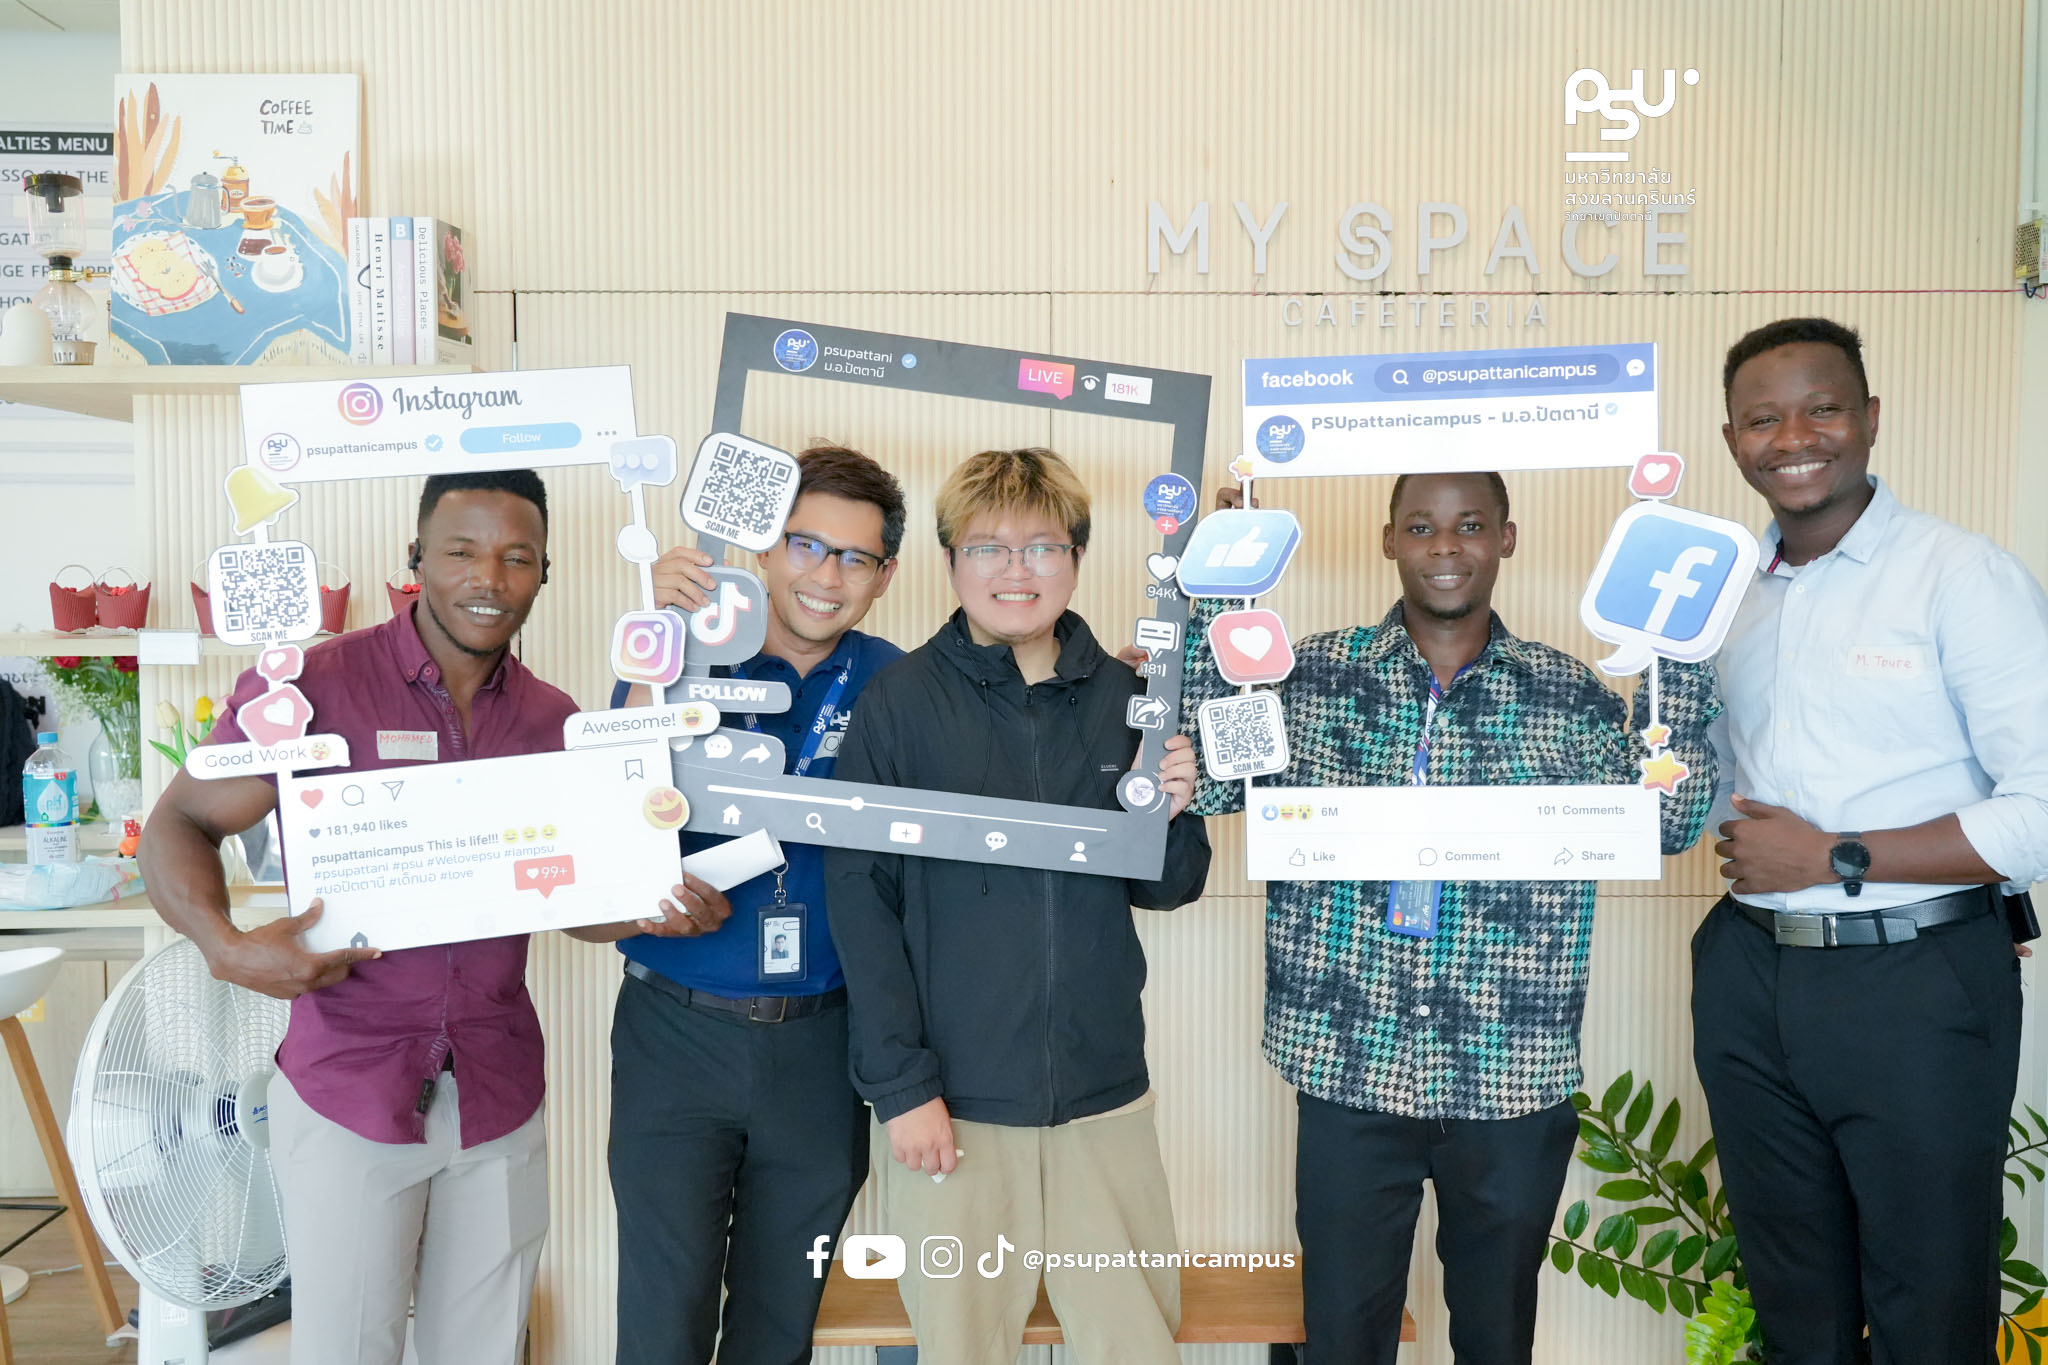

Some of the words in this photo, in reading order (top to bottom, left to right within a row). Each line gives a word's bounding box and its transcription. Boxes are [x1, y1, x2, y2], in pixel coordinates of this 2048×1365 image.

[259, 99, 313, 115] COFFEE
[260, 119, 294, 135] TIME
[58, 136, 107, 151] MENU
[77, 170, 109, 183] THE
[395, 223, 406, 238] B
[1147, 201, 1290, 275] MY
[1335, 200, 1690, 281] SPACE
[374, 233, 385, 279] Henri
[418, 226, 429, 285] Delicious
[376, 288, 386, 350] Matisse
[419, 291, 430, 330] Places
[1281, 299, 1548, 327] CAFETERIA
[823, 346, 893, 364] psupattani
[823, 362, 885, 378] ม.อ.ปัตตานี
[1028, 368, 1064, 385] LIVE
[1261, 368, 1354, 388] facebook
[1422, 364, 1598, 385] @psupattanicampus
[1112, 383, 1139, 396] 181K
[392, 385, 523, 420] Instagram
[1311, 413, 1482, 432] PSUpattanicampus
[1501, 403, 1600, 424] ม.อ.ปัตตานี
[502, 432, 541, 444] Follow
[306, 440, 418, 459] psupattanicampus
[705, 519, 727, 536] SCAN
[726, 526, 740, 540] ME
[250, 631, 273, 642] SCAN
[274, 630, 288, 640] ME
[688, 683, 767, 702] FOLLOW
[582, 712, 677, 736] Awesome!
[204, 750, 253, 767] Good
[258, 746, 307, 762] Work
[1232, 762, 1252, 773] SCAN
[1253, 760, 1266, 770] ME
[1321, 807, 1339, 817] 6M
[1537, 805, 1557, 816] 101
[1562, 805, 1626, 816] Comments
[326, 821, 376, 837] 181,940
[379, 819, 408, 831] likes
[311, 844, 424, 867] psupattanicampus
[426, 839, 453, 851] This
[456, 837, 466, 848] is
[469, 833, 500, 846] life!!!
[1313, 852, 1336, 862] Like
[1445, 851, 1501, 861] Comment
[1581, 850, 1616, 861] Share
[314, 862, 389, 881] #psupattani
[392, 859, 424, 872] #psu
[427, 851, 501, 867] #Welovepsu
[504, 845, 555, 858] #iampsu
[541, 865, 569, 879] 99+
[440, 869, 474, 881] #love
